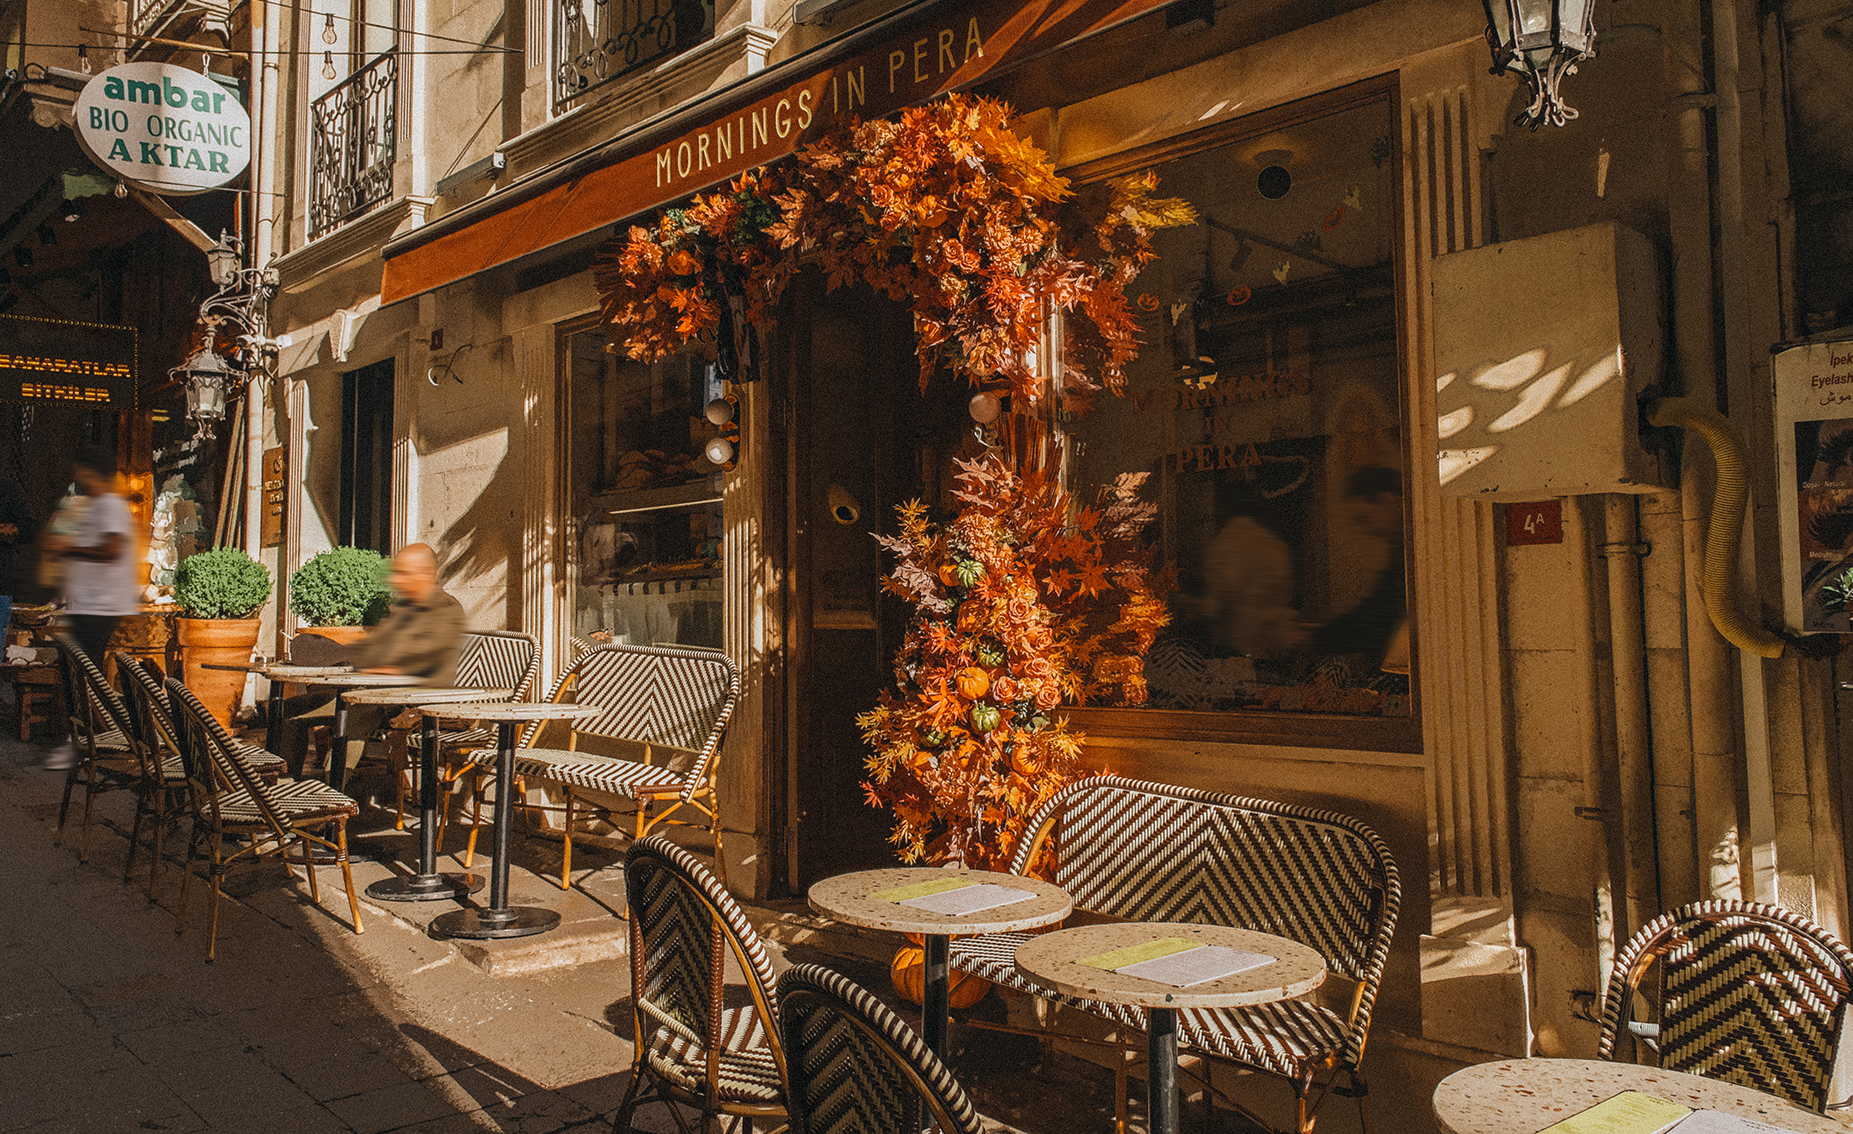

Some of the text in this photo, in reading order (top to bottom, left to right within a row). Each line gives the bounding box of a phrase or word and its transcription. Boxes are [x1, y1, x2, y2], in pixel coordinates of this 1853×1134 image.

[104, 76, 225, 114] ambar
[656, 17, 984, 187] MORNINGS IN PERA
[89, 106, 243, 148] BIO ORGANIC
[108, 138, 230, 174] AKTAR
[1131, 369, 1311, 414] MORNINGS
[1811, 372, 1853, 389] Eyelash
[1205, 416, 1230, 435] IN
[1175, 442, 1263, 474] PERA
